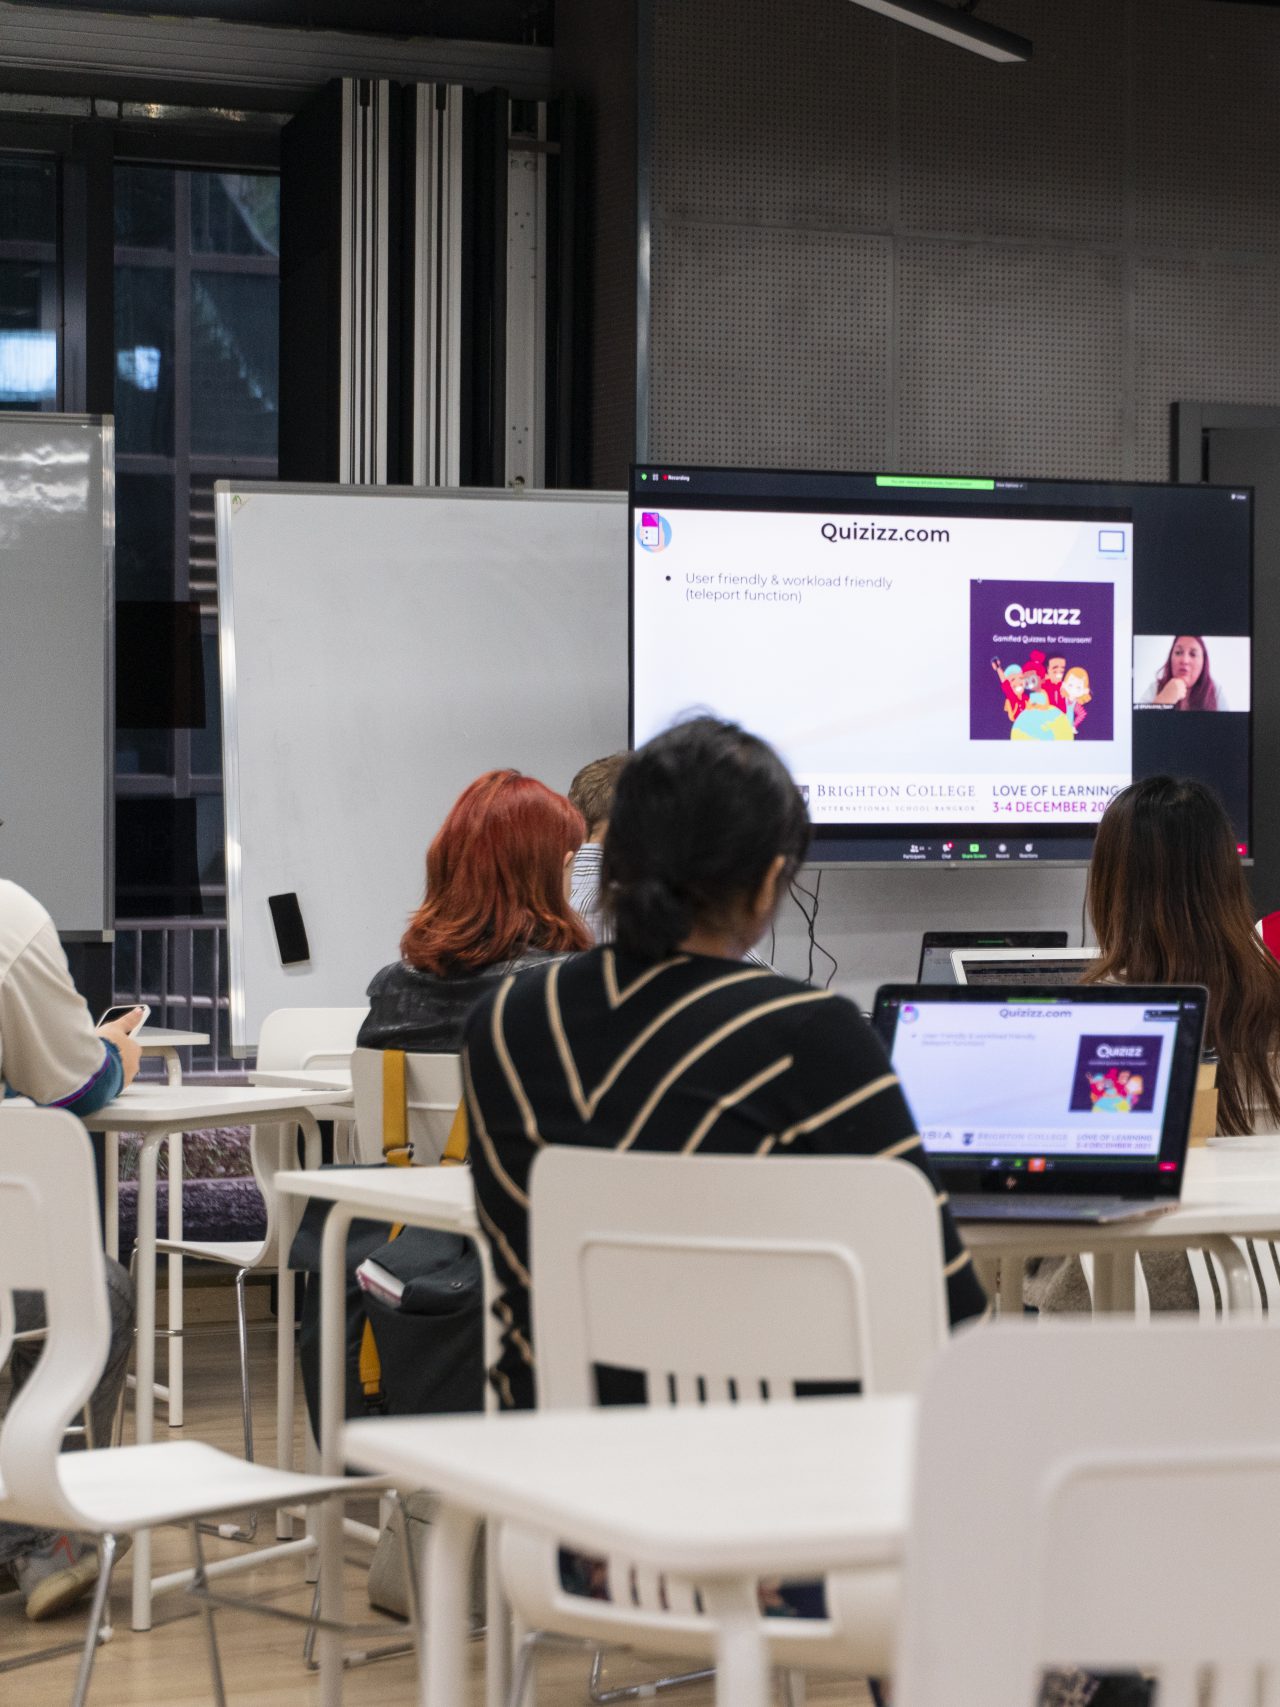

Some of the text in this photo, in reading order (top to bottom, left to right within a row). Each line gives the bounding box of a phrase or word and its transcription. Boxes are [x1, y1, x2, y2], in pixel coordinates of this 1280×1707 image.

[821, 522, 950, 543] Quizizz.com
[686, 573, 893, 591] User friendly & workload friendly
[685, 588, 802, 603] (teleport function)
[817, 784, 976, 798] BRIGHTON COLLEGE
[993, 785, 1119, 797] LOVE OF LEARNING
[992, 801, 1106, 813] 3-4 DECEMBER 20
[999, 1008, 1072, 1019] Quizizz.com
